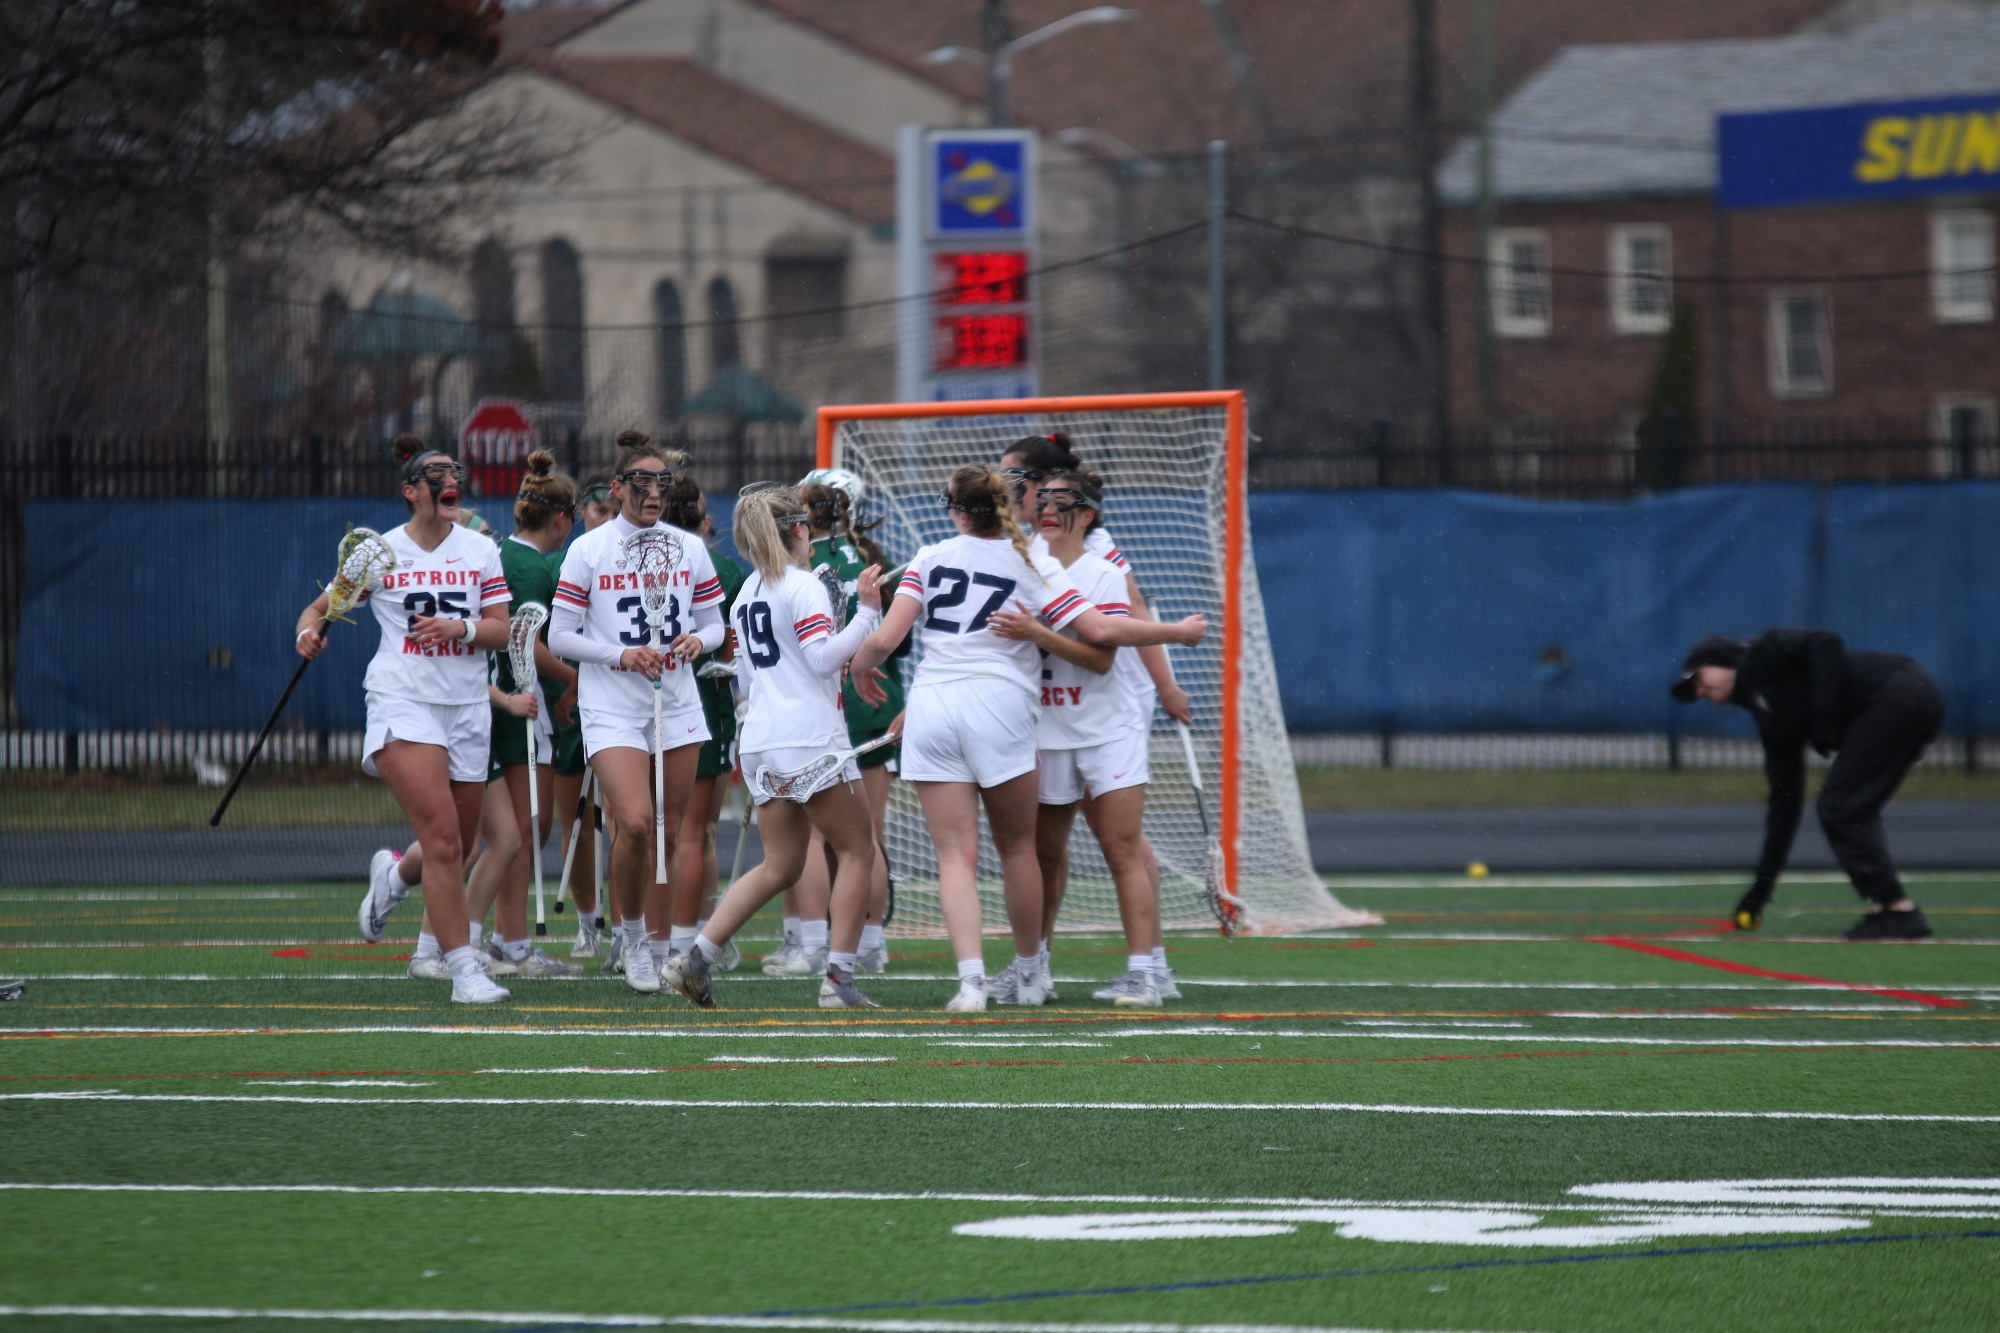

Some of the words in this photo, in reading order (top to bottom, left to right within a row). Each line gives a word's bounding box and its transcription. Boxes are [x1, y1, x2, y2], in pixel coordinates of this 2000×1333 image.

[1854, 112, 2000, 182] SUN
[467, 428, 529, 465] STOP
[383, 570, 480, 589] DETROIT
[599, 571, 690, 591] DETROIT
[924, 565, 1017, 635] 27
[616, 594, 682, 647] 33
[736, 601, 781, 670] 19
[1041, 686, 1083, 707] RCY
